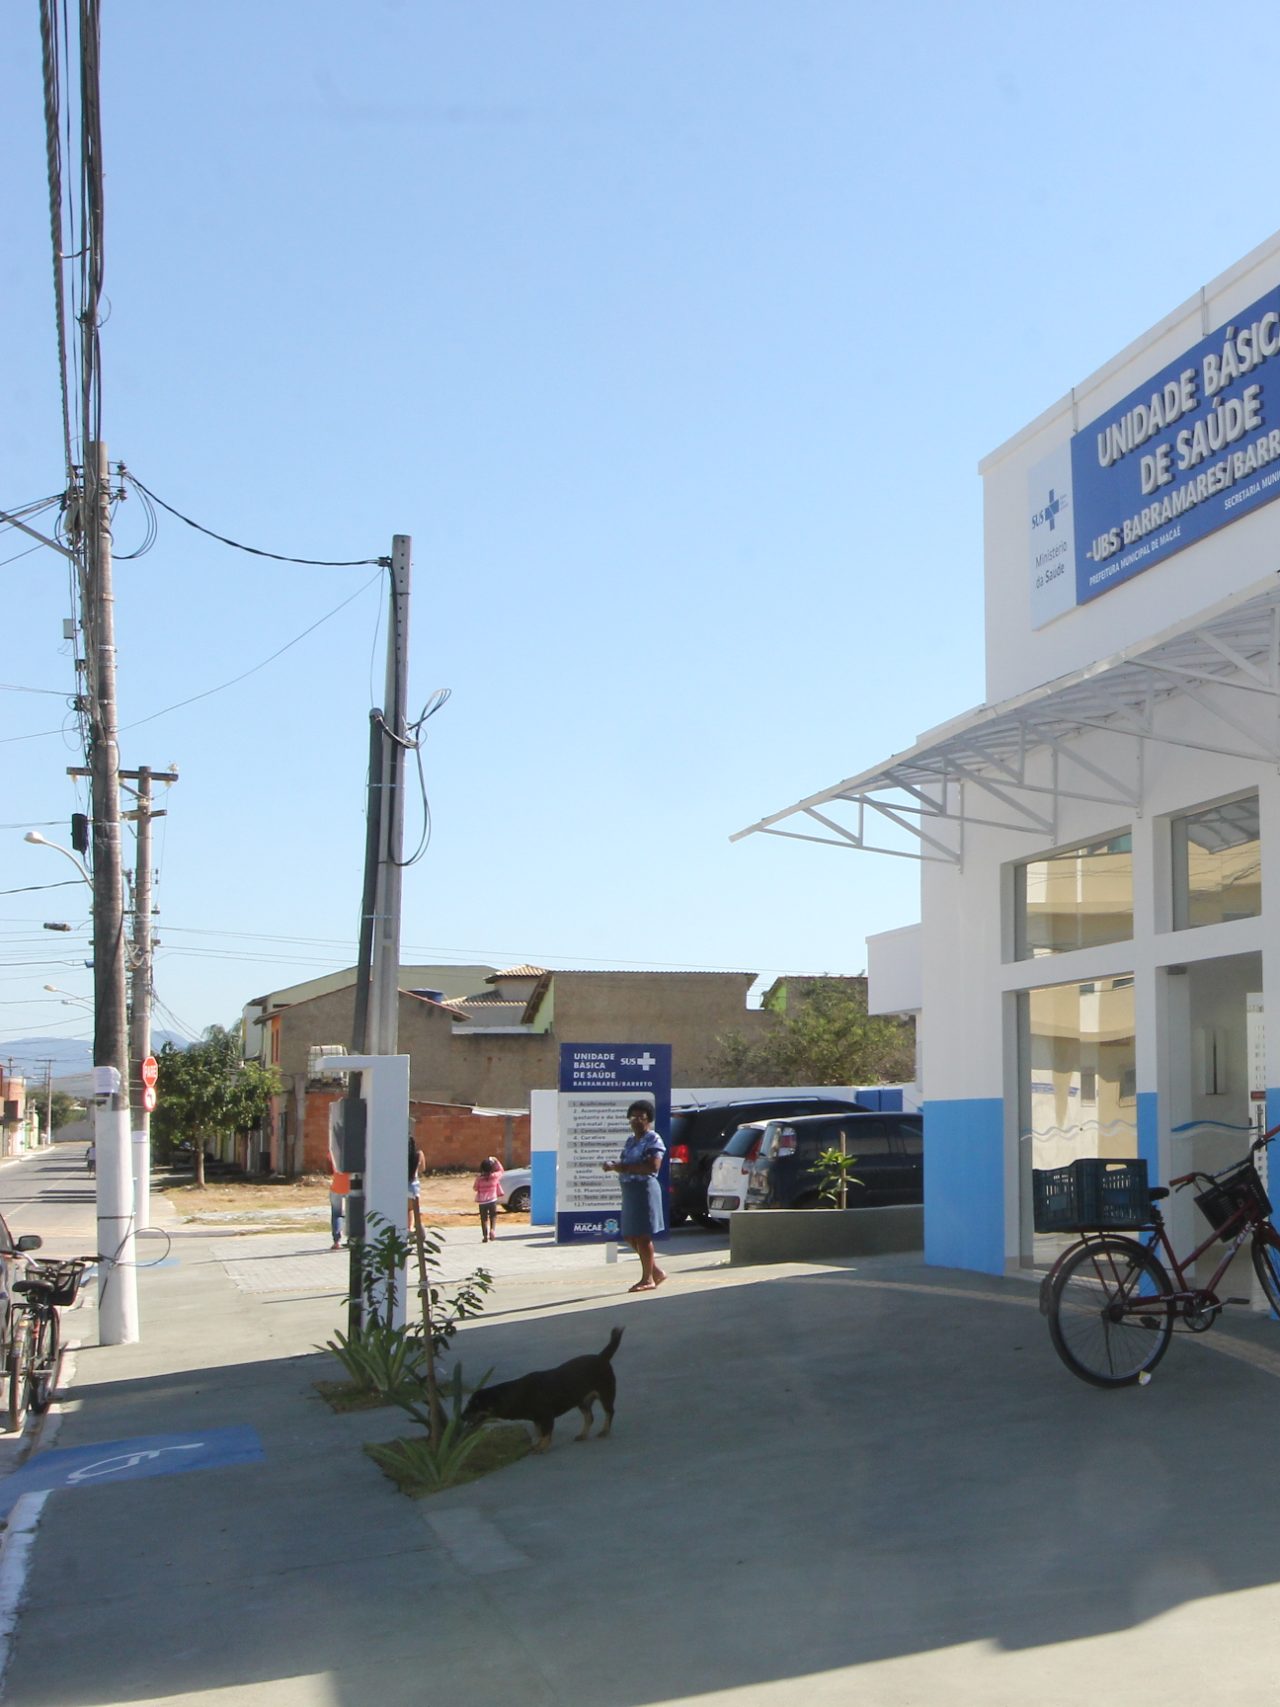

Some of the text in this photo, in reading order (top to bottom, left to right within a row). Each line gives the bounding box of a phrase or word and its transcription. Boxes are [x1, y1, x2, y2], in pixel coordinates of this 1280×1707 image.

[1097, 368, 1198, 467] UNIDADE
[1140, 384, 1263, 495] DE SAÚDE
[1224, 480, 1261, 510] SECRETARIA
[1031, 510, 1045, 530] SUS
[1088, 524, 1182, 587] PREFEITURA MUNICIPAL DE MACAÉ
[573, 1060, 606, 1069] BÁSICA
[620, 1058, 636, 1066] SUS
[573, 1069, 616, 1079] DE SAÚDE
[573, 1222, 603, 1232] MACAÉ
